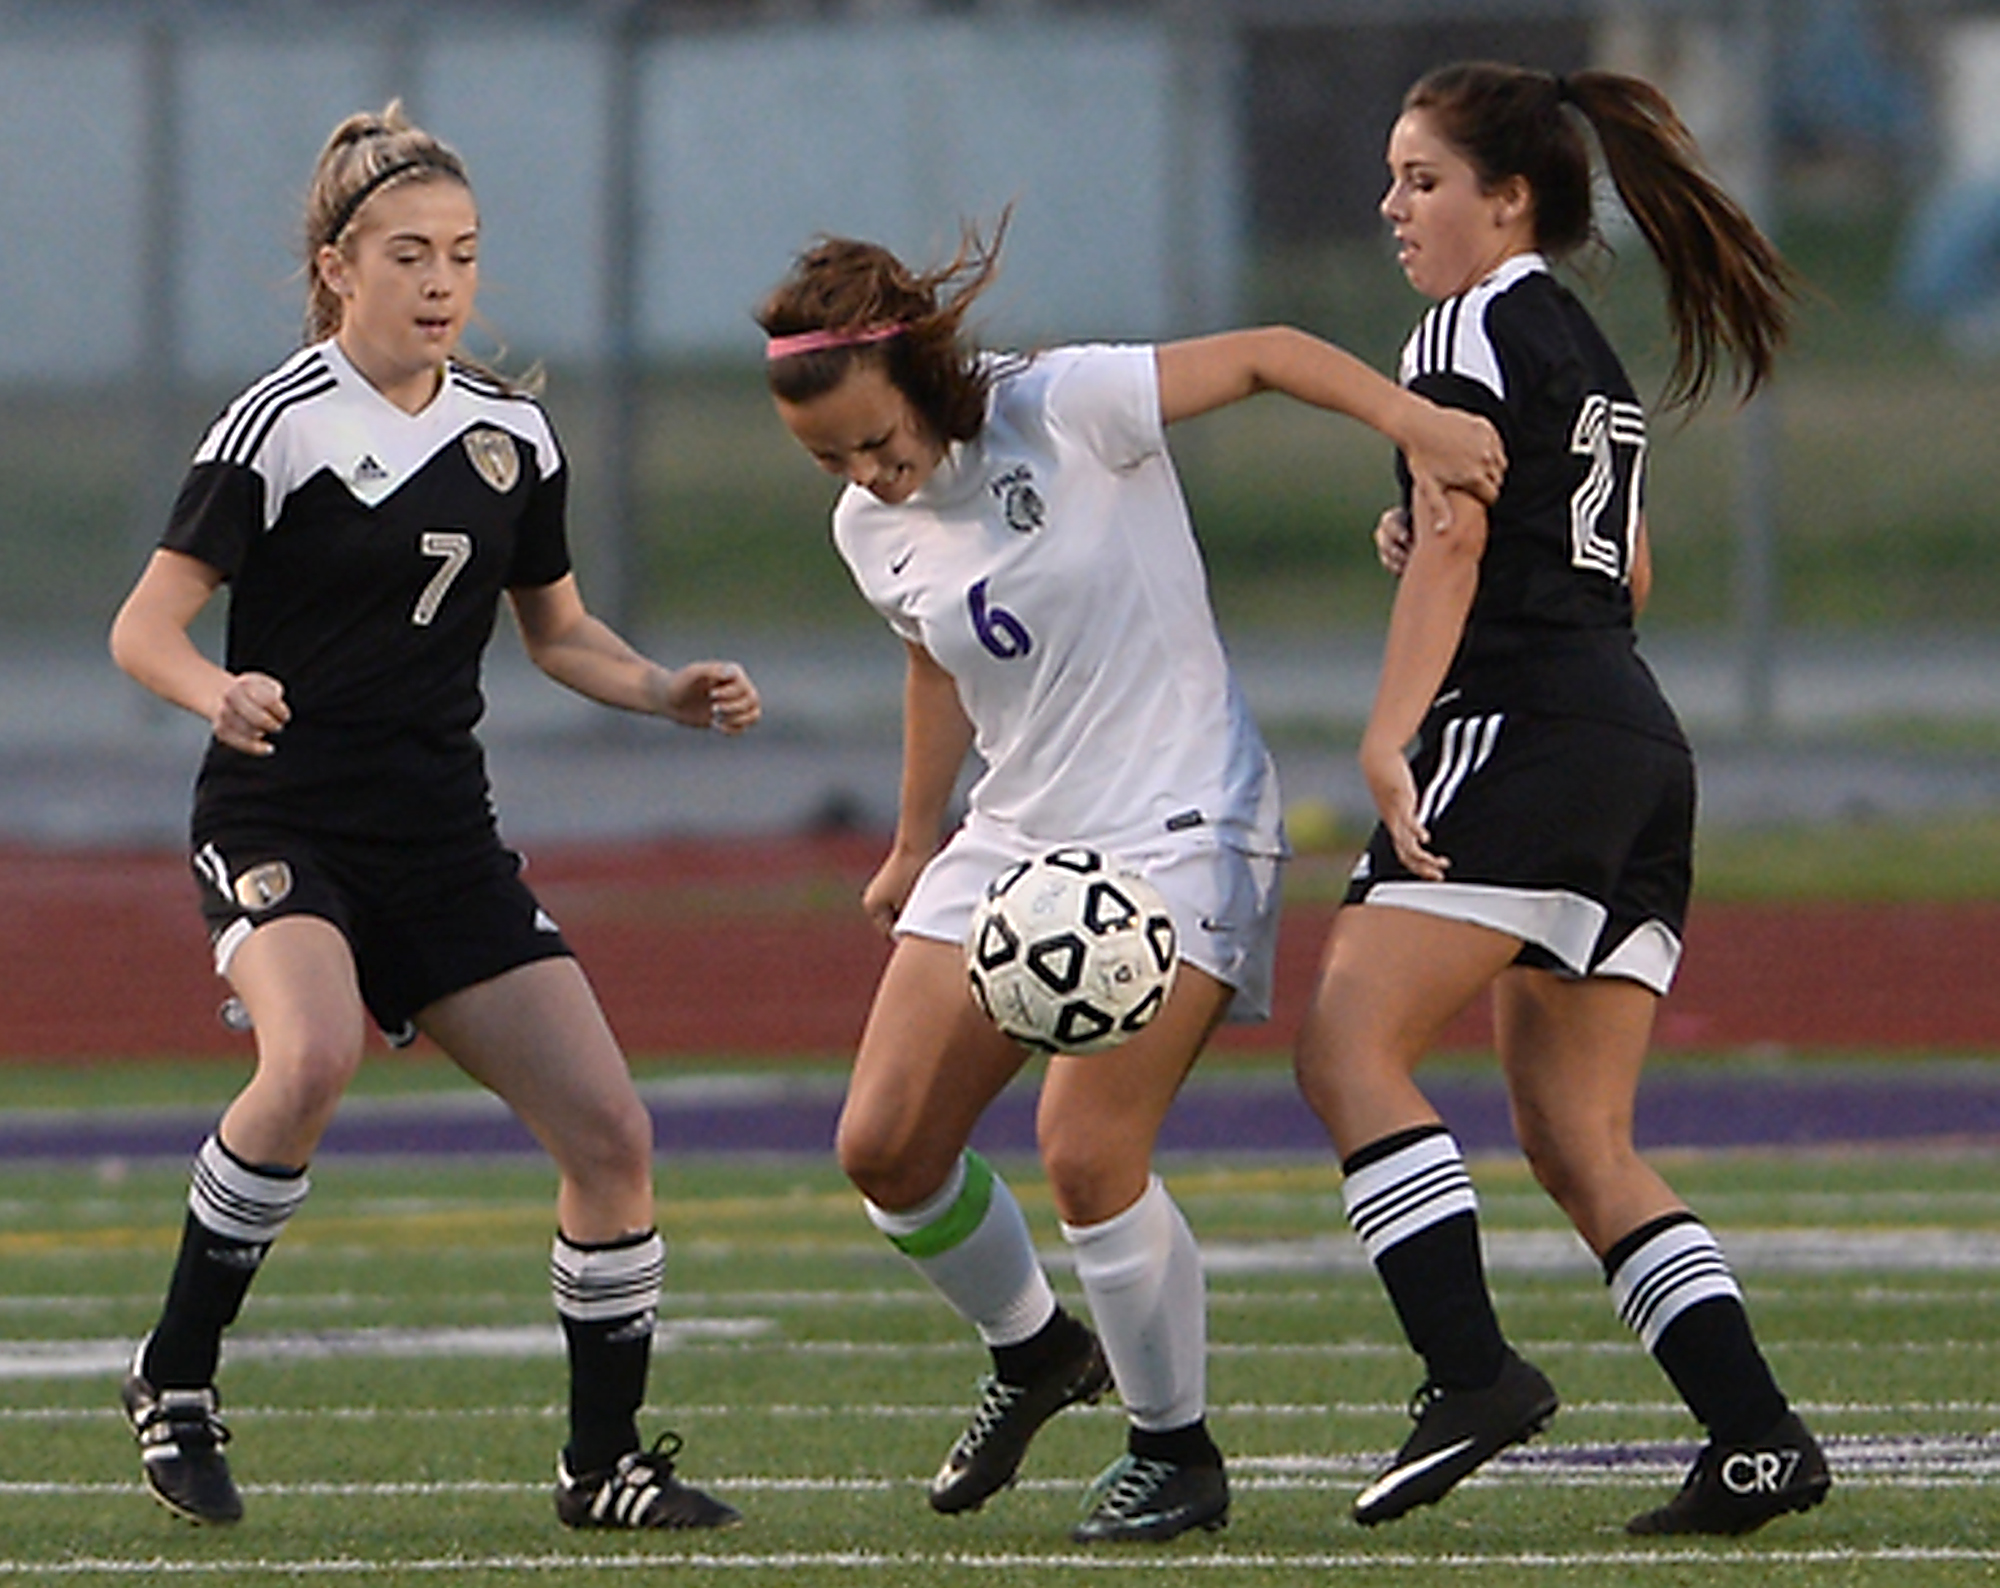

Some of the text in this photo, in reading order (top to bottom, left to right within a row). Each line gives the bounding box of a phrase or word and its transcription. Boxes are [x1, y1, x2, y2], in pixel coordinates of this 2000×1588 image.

[1570, 394, 1646, 584] 27
[412, 531, 473, 626] 7
[967, 577, 1032, 660] 6
[1721, 1451, 1800, 1494] CR7
